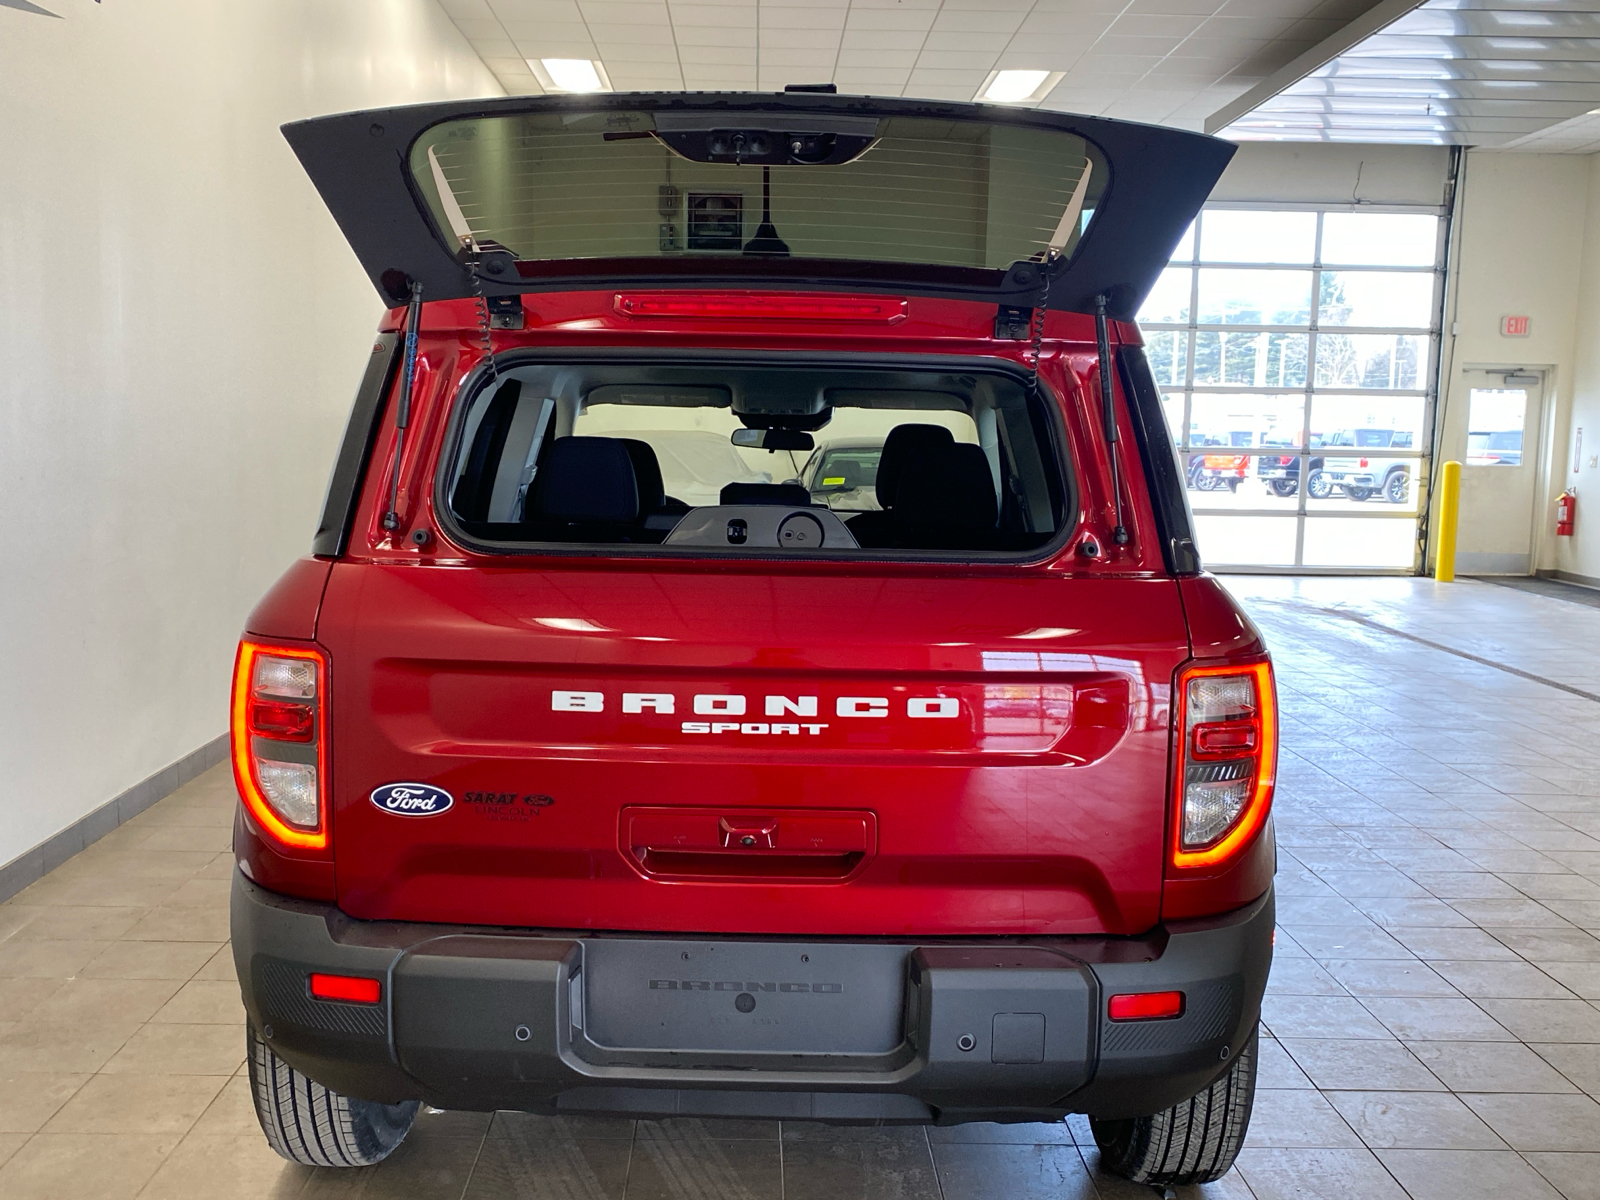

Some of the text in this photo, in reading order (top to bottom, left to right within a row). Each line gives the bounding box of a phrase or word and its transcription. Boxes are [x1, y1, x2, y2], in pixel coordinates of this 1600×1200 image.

[1507, 316, 1528, 334] EXIT
[551, 690, 960, 718] BRONCO
[681, 722, 829, 735] SPORT
[386, 787, 438, 811] Ford
[463, 791, 518, 804] SARAT
[475, 806, 540, 816] LINCOLN
[649, 980, 843, 993] BRONCO
